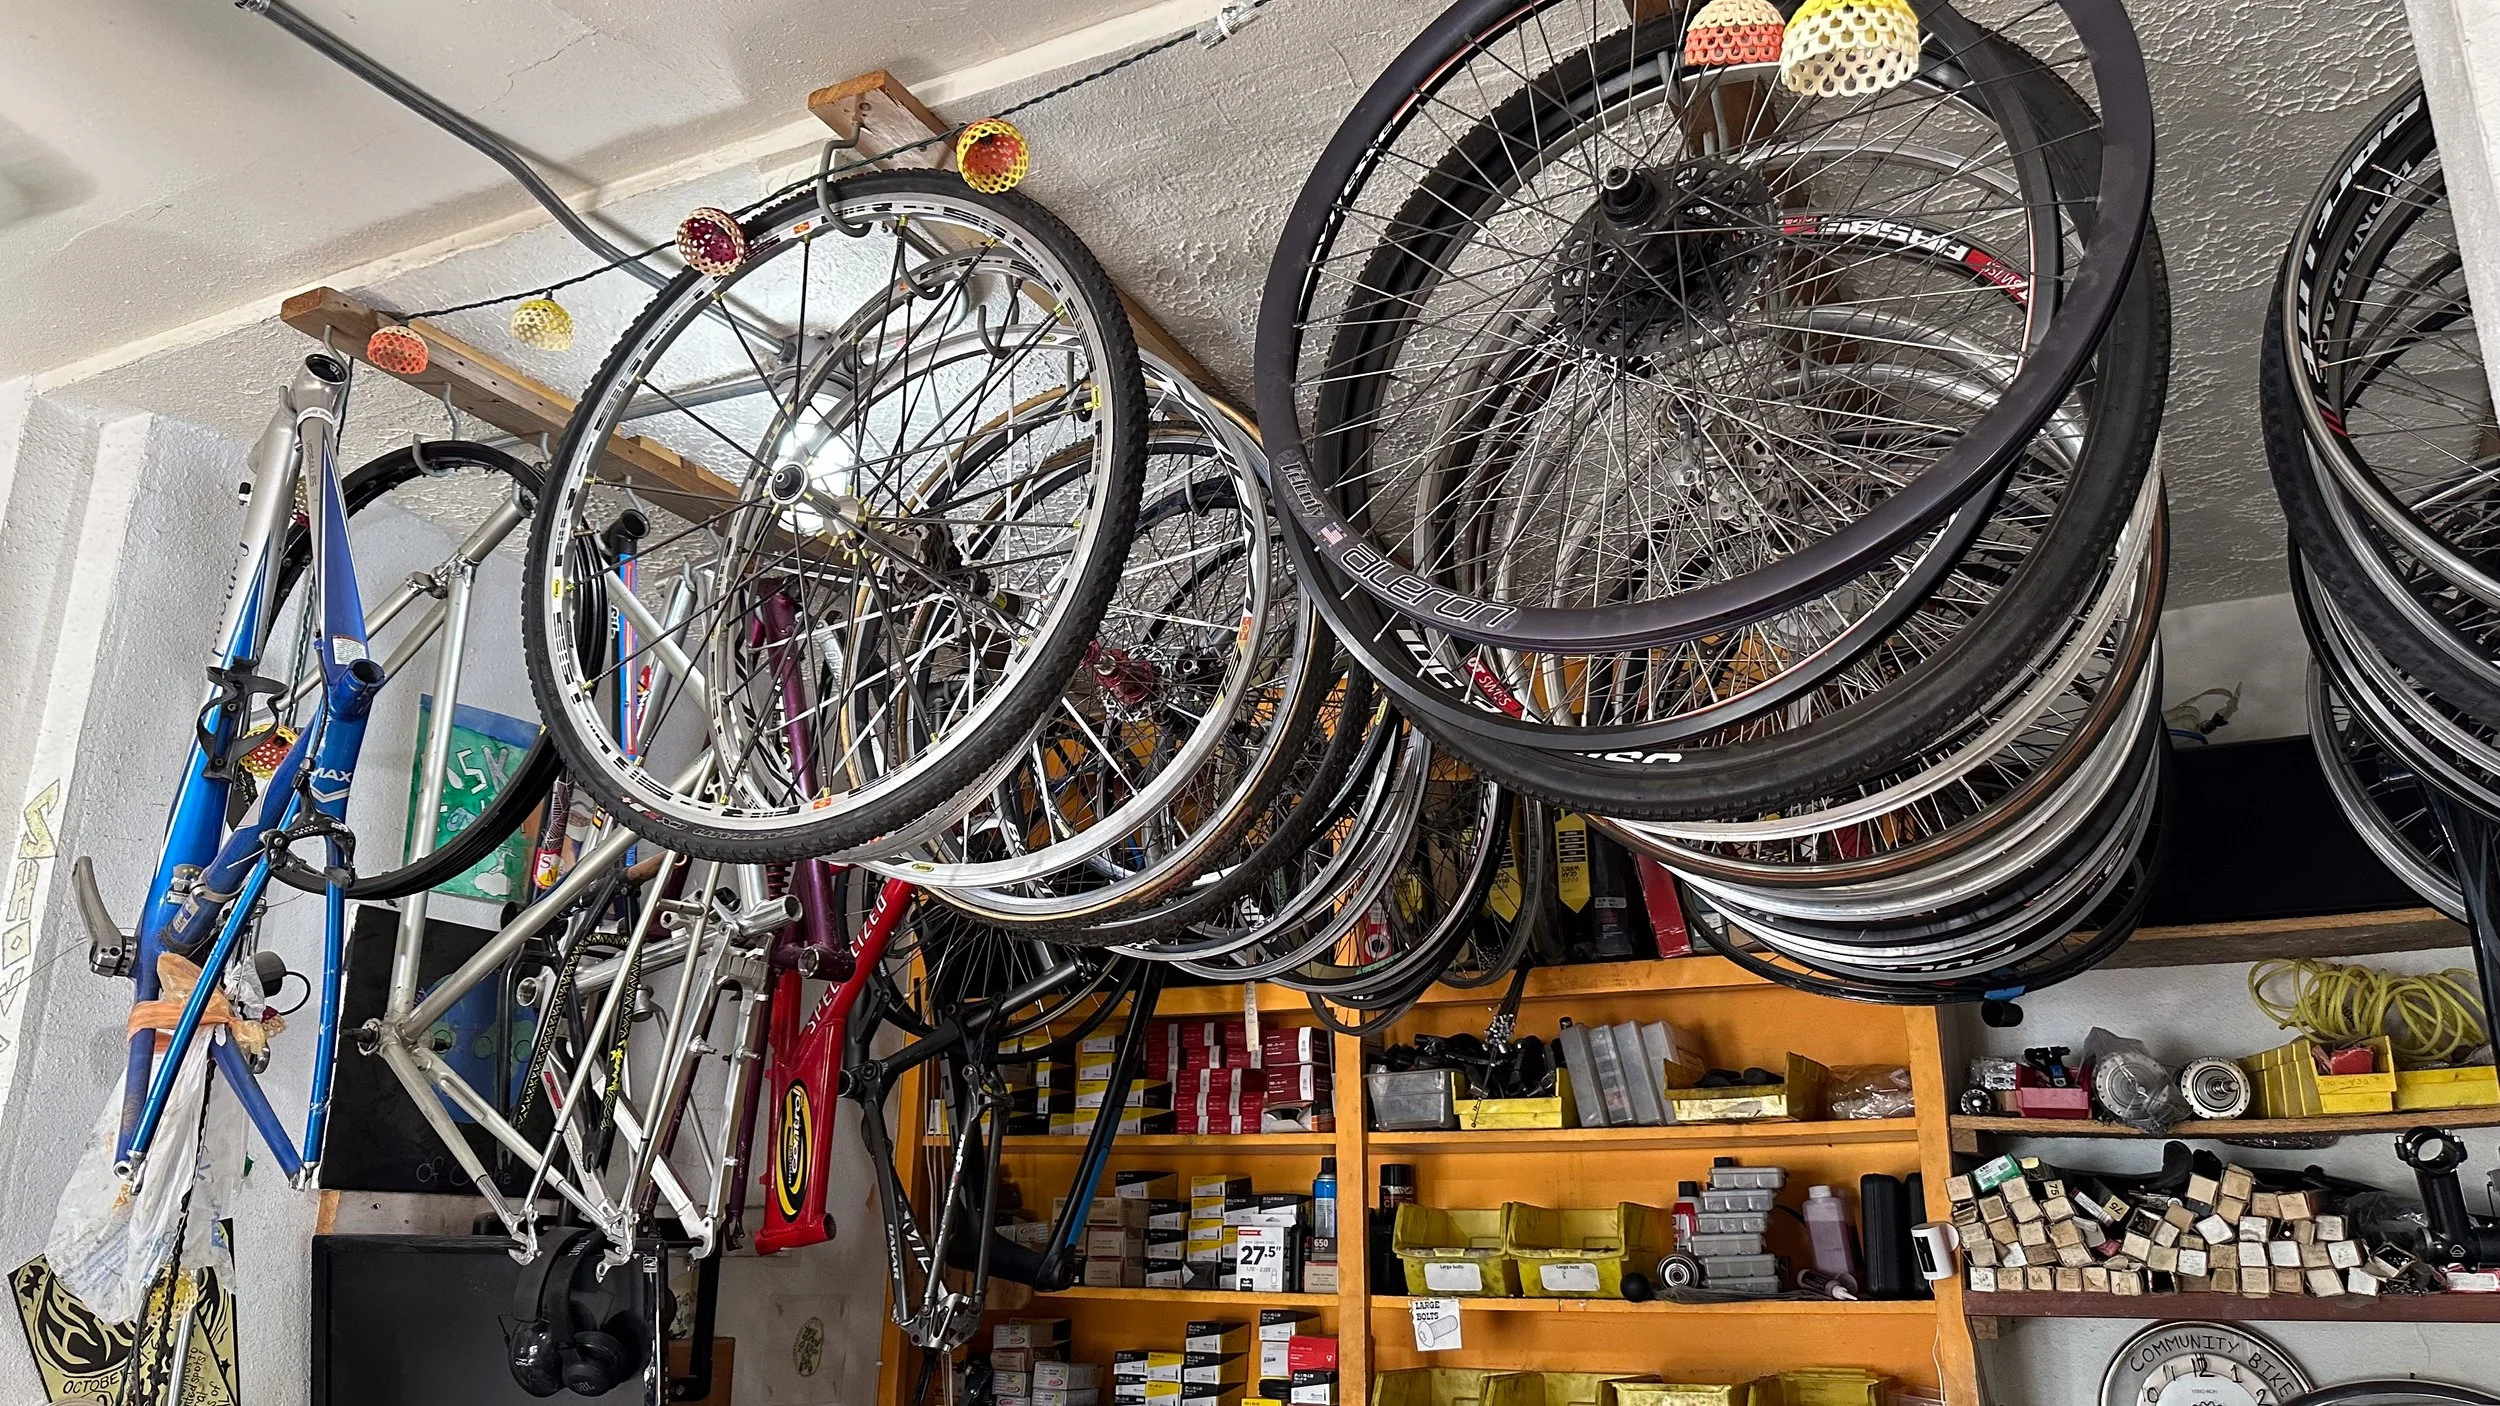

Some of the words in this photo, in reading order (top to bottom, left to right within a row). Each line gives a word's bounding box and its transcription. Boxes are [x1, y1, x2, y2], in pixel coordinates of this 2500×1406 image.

[809, 893, 888, 1035] SPECLIZED
[2049, 1183, 2060, 1196] 75
[2109, 1201, 2123, 1215] 75
[887, 1223, 901, 1280] DAKAR
[1313, 1238, 1329, 1248] 650
[1415, 1301, 1441, 1310] LARGE
[1416, 1312, 1440, 1321] BOLTS
[2130, 1334, 2239, 1373] COMMUNITY
[2248, 1352, 2295, 1398] BIKE
[2191, 1356, 2215, 1378] 12
[2230, 1364, 2243, 1384] 1
[62, 1370, 126, 1395] OCTOBE
[210, 1384, 221, 1399] of
[2256, 1388, 2272, 1406] 2
